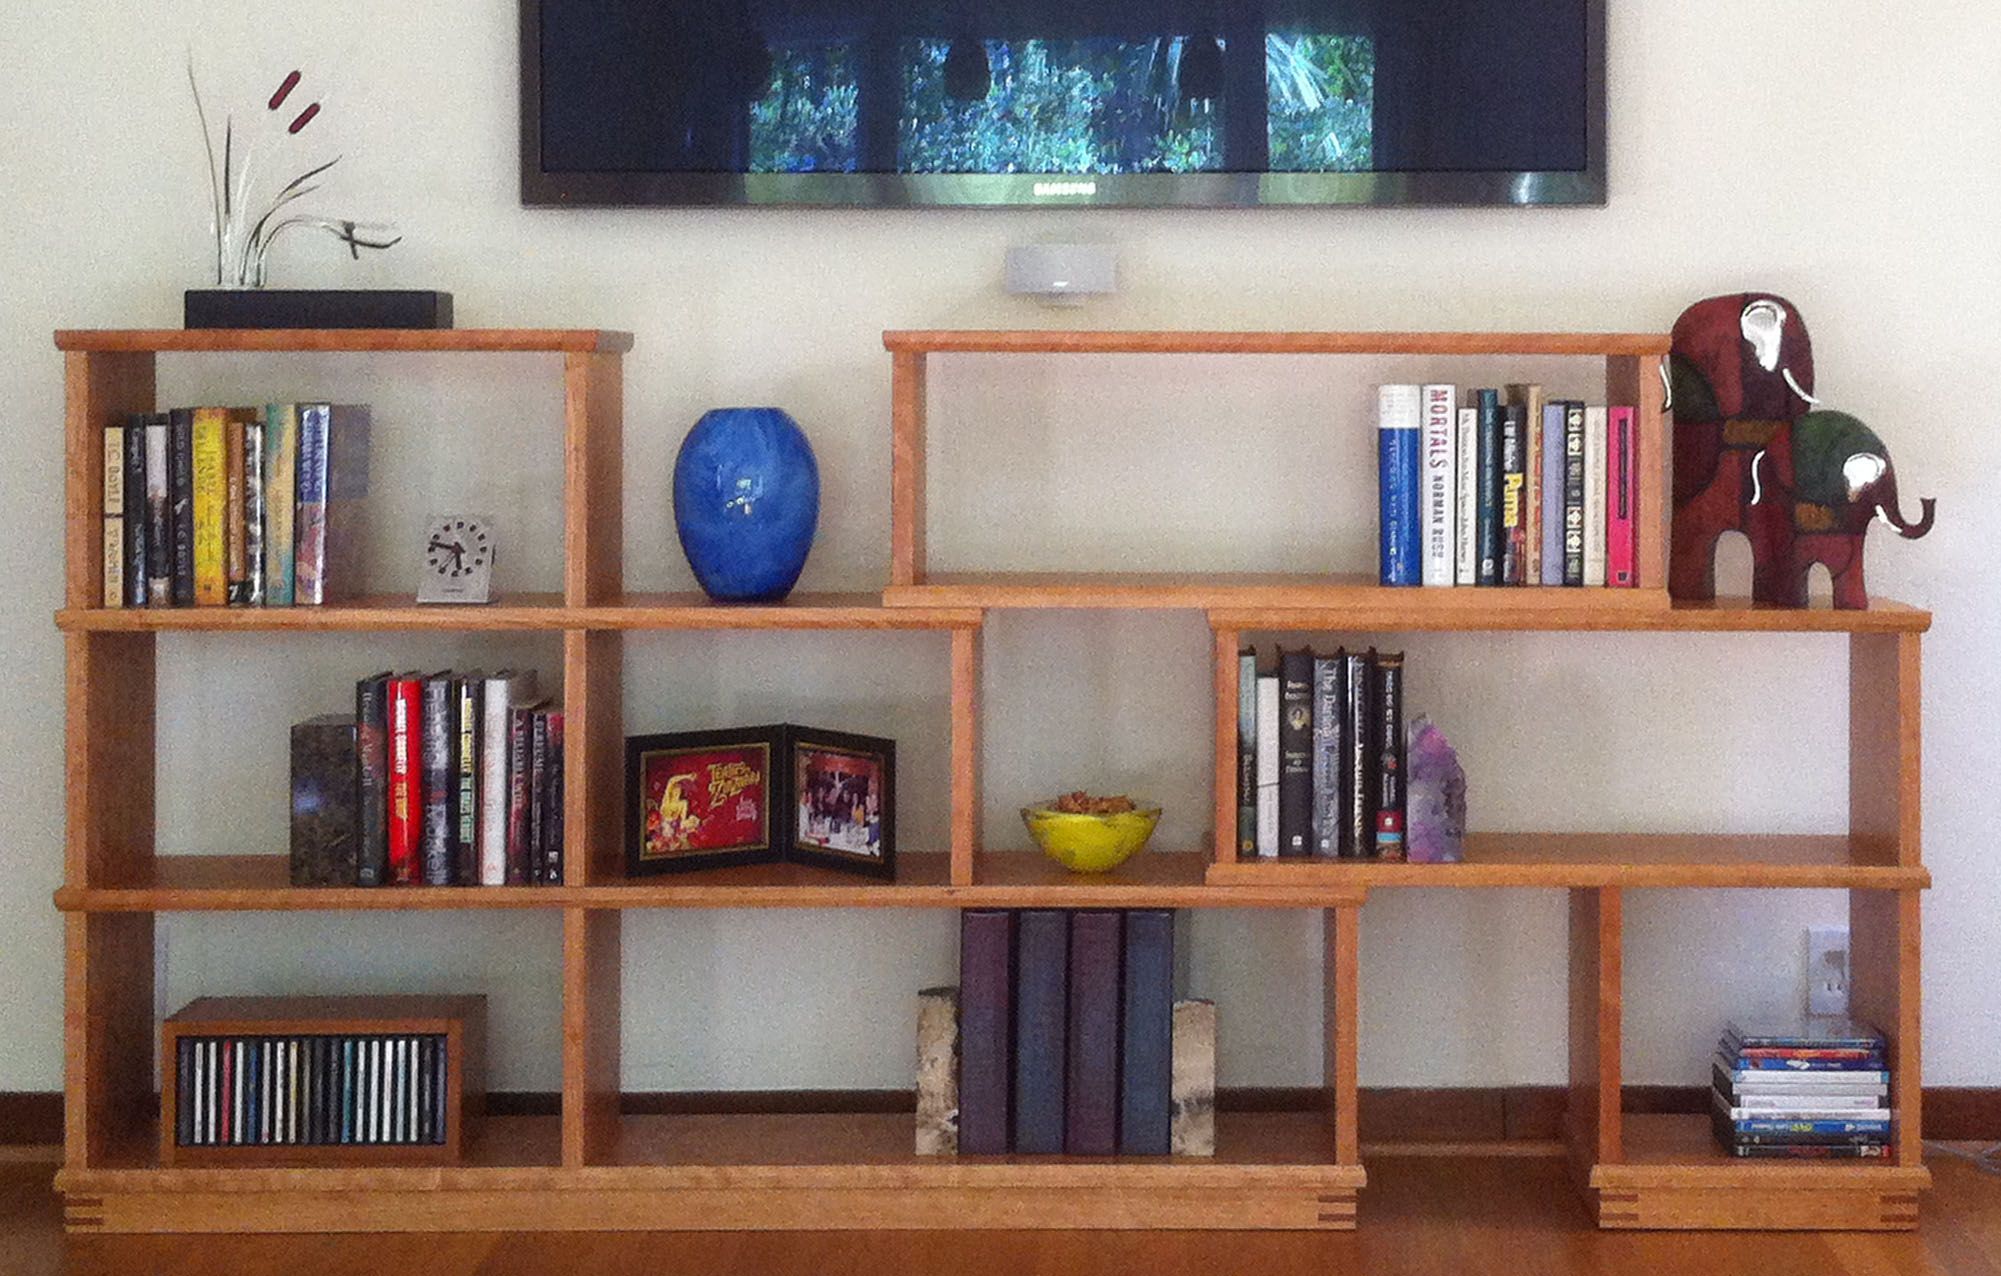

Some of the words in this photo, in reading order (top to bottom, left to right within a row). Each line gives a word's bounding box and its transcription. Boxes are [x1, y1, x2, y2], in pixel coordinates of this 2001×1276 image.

[1429, 389, 1448, 470] MORTALS
[1432, 475, 1446, 524] NORMAN
[1321, 668, 1337, 691] The
